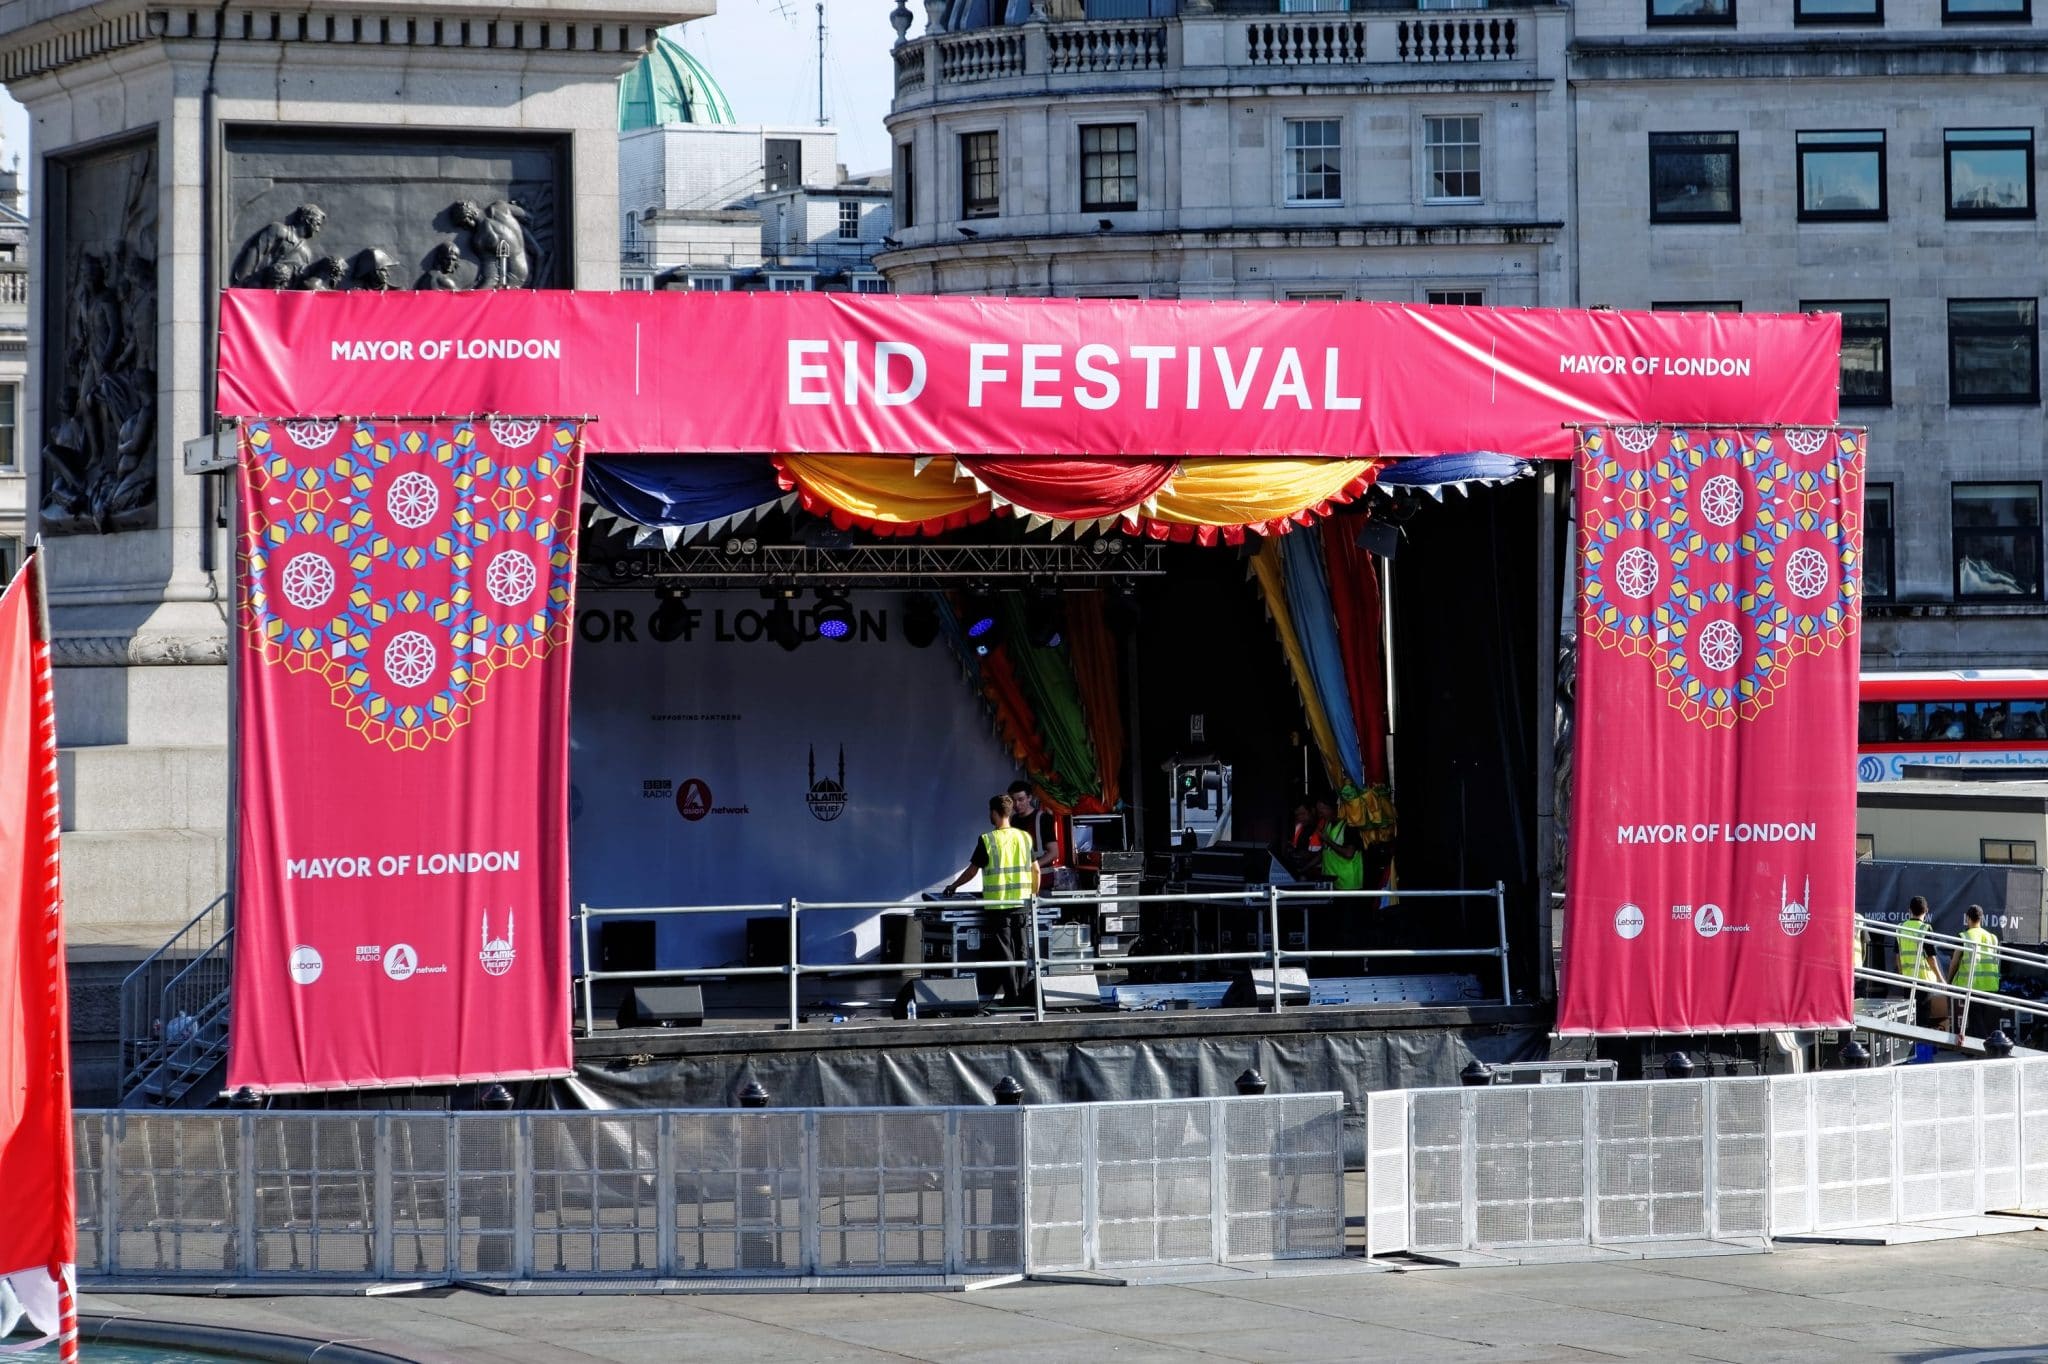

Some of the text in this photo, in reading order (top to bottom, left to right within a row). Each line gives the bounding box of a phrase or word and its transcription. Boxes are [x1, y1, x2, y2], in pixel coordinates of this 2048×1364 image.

[331, 339, 560, 360] MAYOR OF LONDON
[1559, 354, 1750, 376] MAYOR OF LONDON
[787, 339, 1362, 411] EID FESTIVAL
[643, 780, 672, 789] BBC
[643, 790, 672, 799] RADIO
[805, 793, 848, 802] ISLAMIC
[683, 804, 749, 815] asian network
[1617, 823, 1816, 844] MAYOR OF LONDON
[287, 850, 519, 880] MAYOR OF LONDON
[1617, 917, 1643, 926] Lebara
[1778, 913, 1811, 921] ISLAMIC
[1901, 912, 1933, 922] LOON
[1963, 913, 2019, 929] LNDON
[1722, 924, 1751, 932] network
[356, 946, 380, 954] BBC
[479, 950, 516, 960] ISLAMIC
[356, 954, 380, 962] RADIO
[391, 964, 447, 975] asian network
